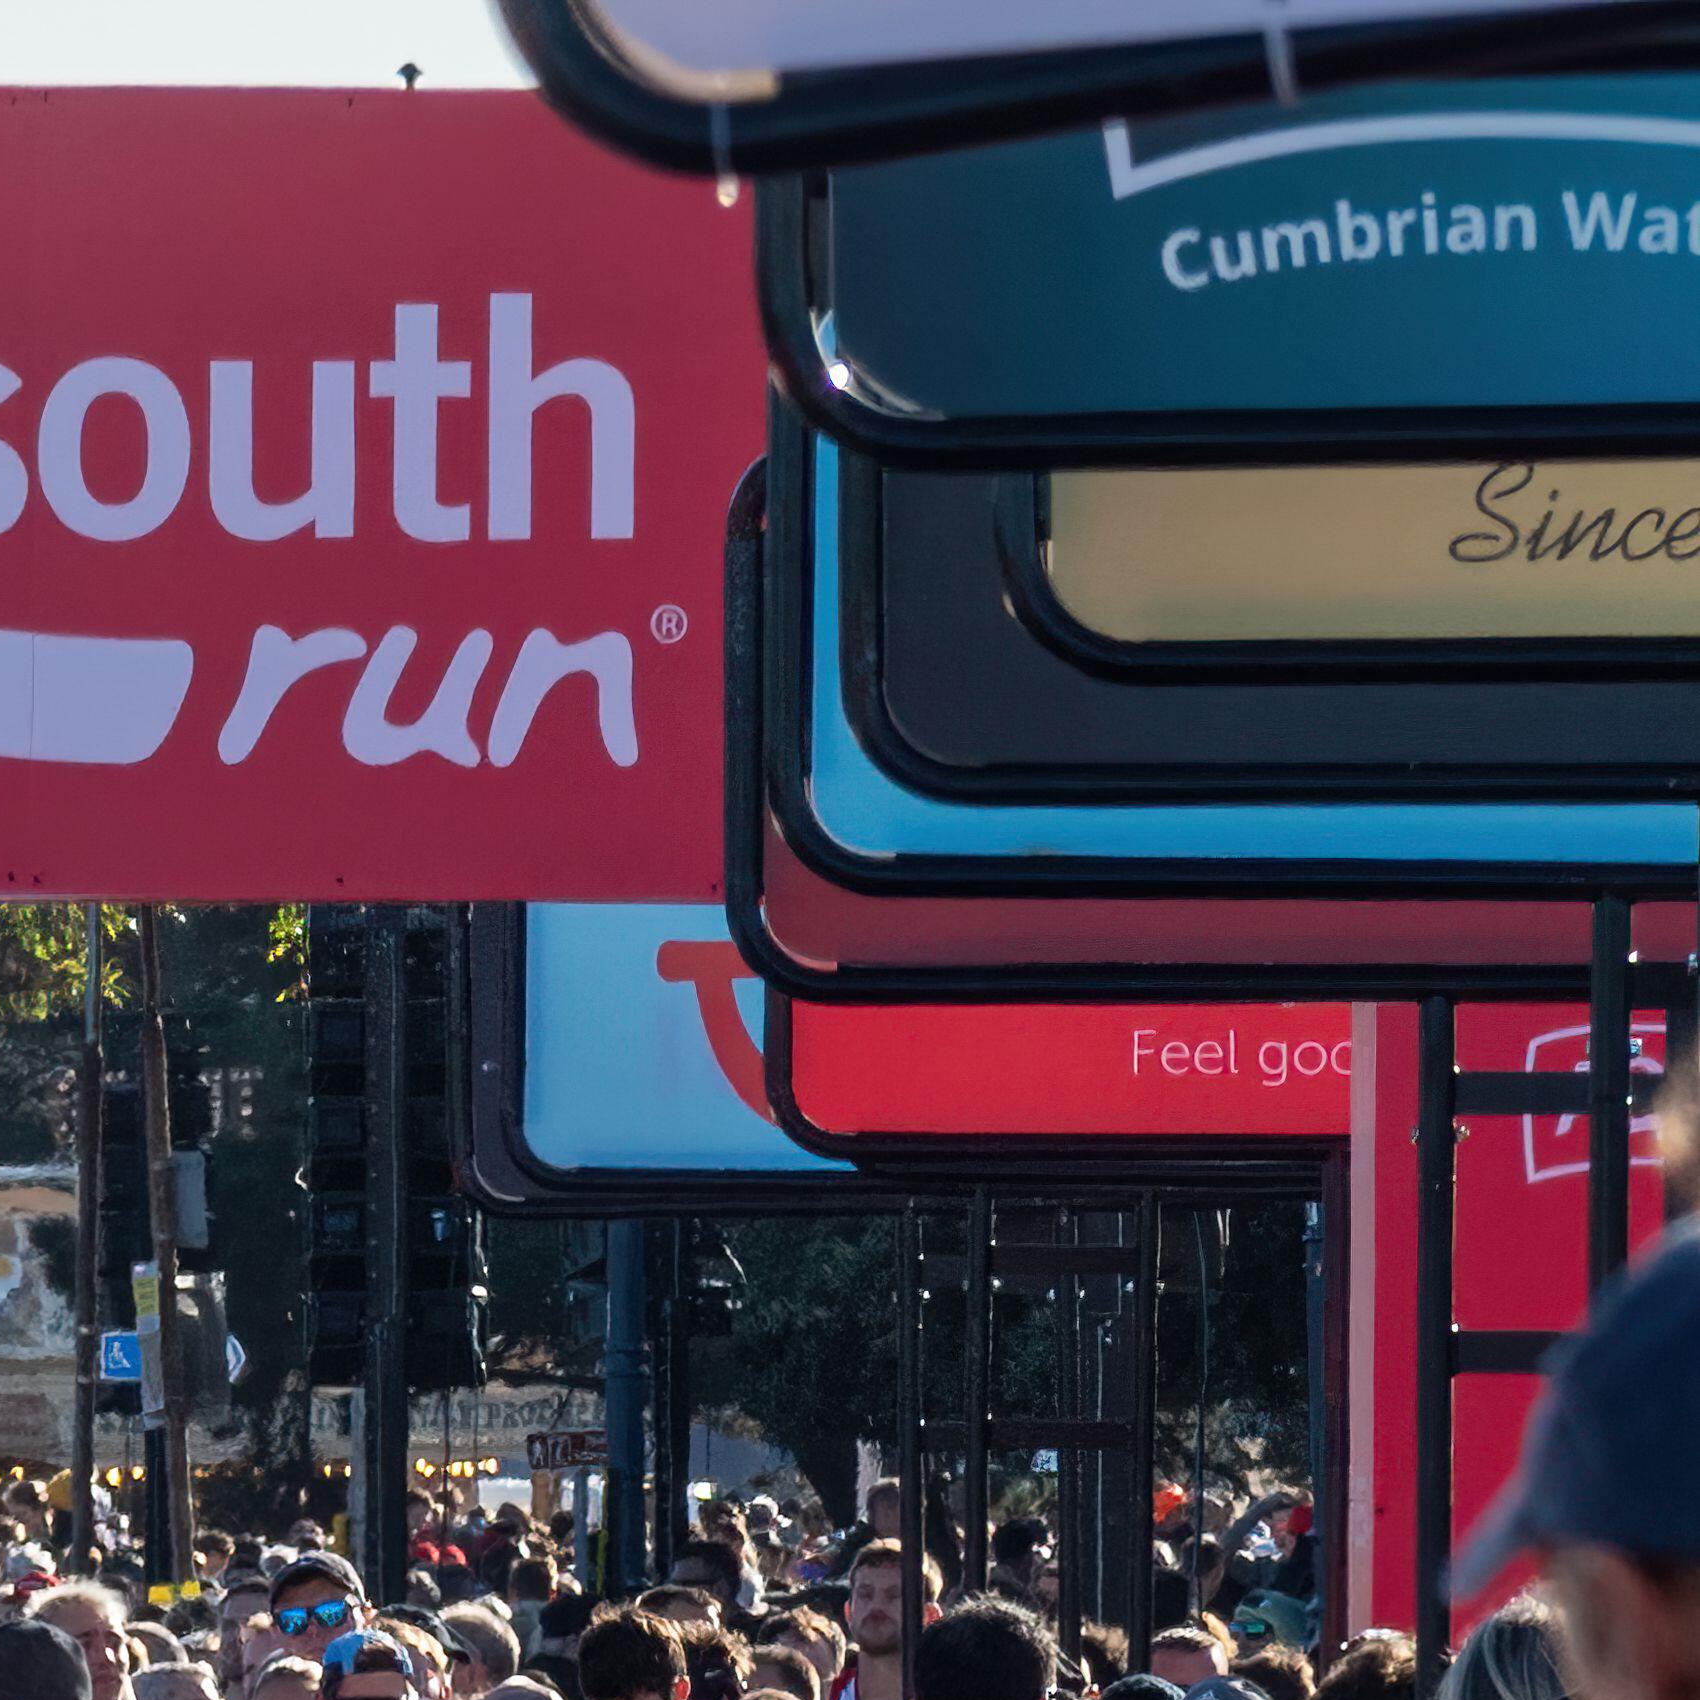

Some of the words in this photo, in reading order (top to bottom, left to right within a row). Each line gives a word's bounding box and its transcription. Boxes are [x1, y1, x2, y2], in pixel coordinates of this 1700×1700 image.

[1161, 190, 1538, 291] Cumbrian
[1448, 462, 1700, 563] Since
[1133, 1029, 1239, 1076] Feel
[1258, 1040, 1352, 1087] goo
